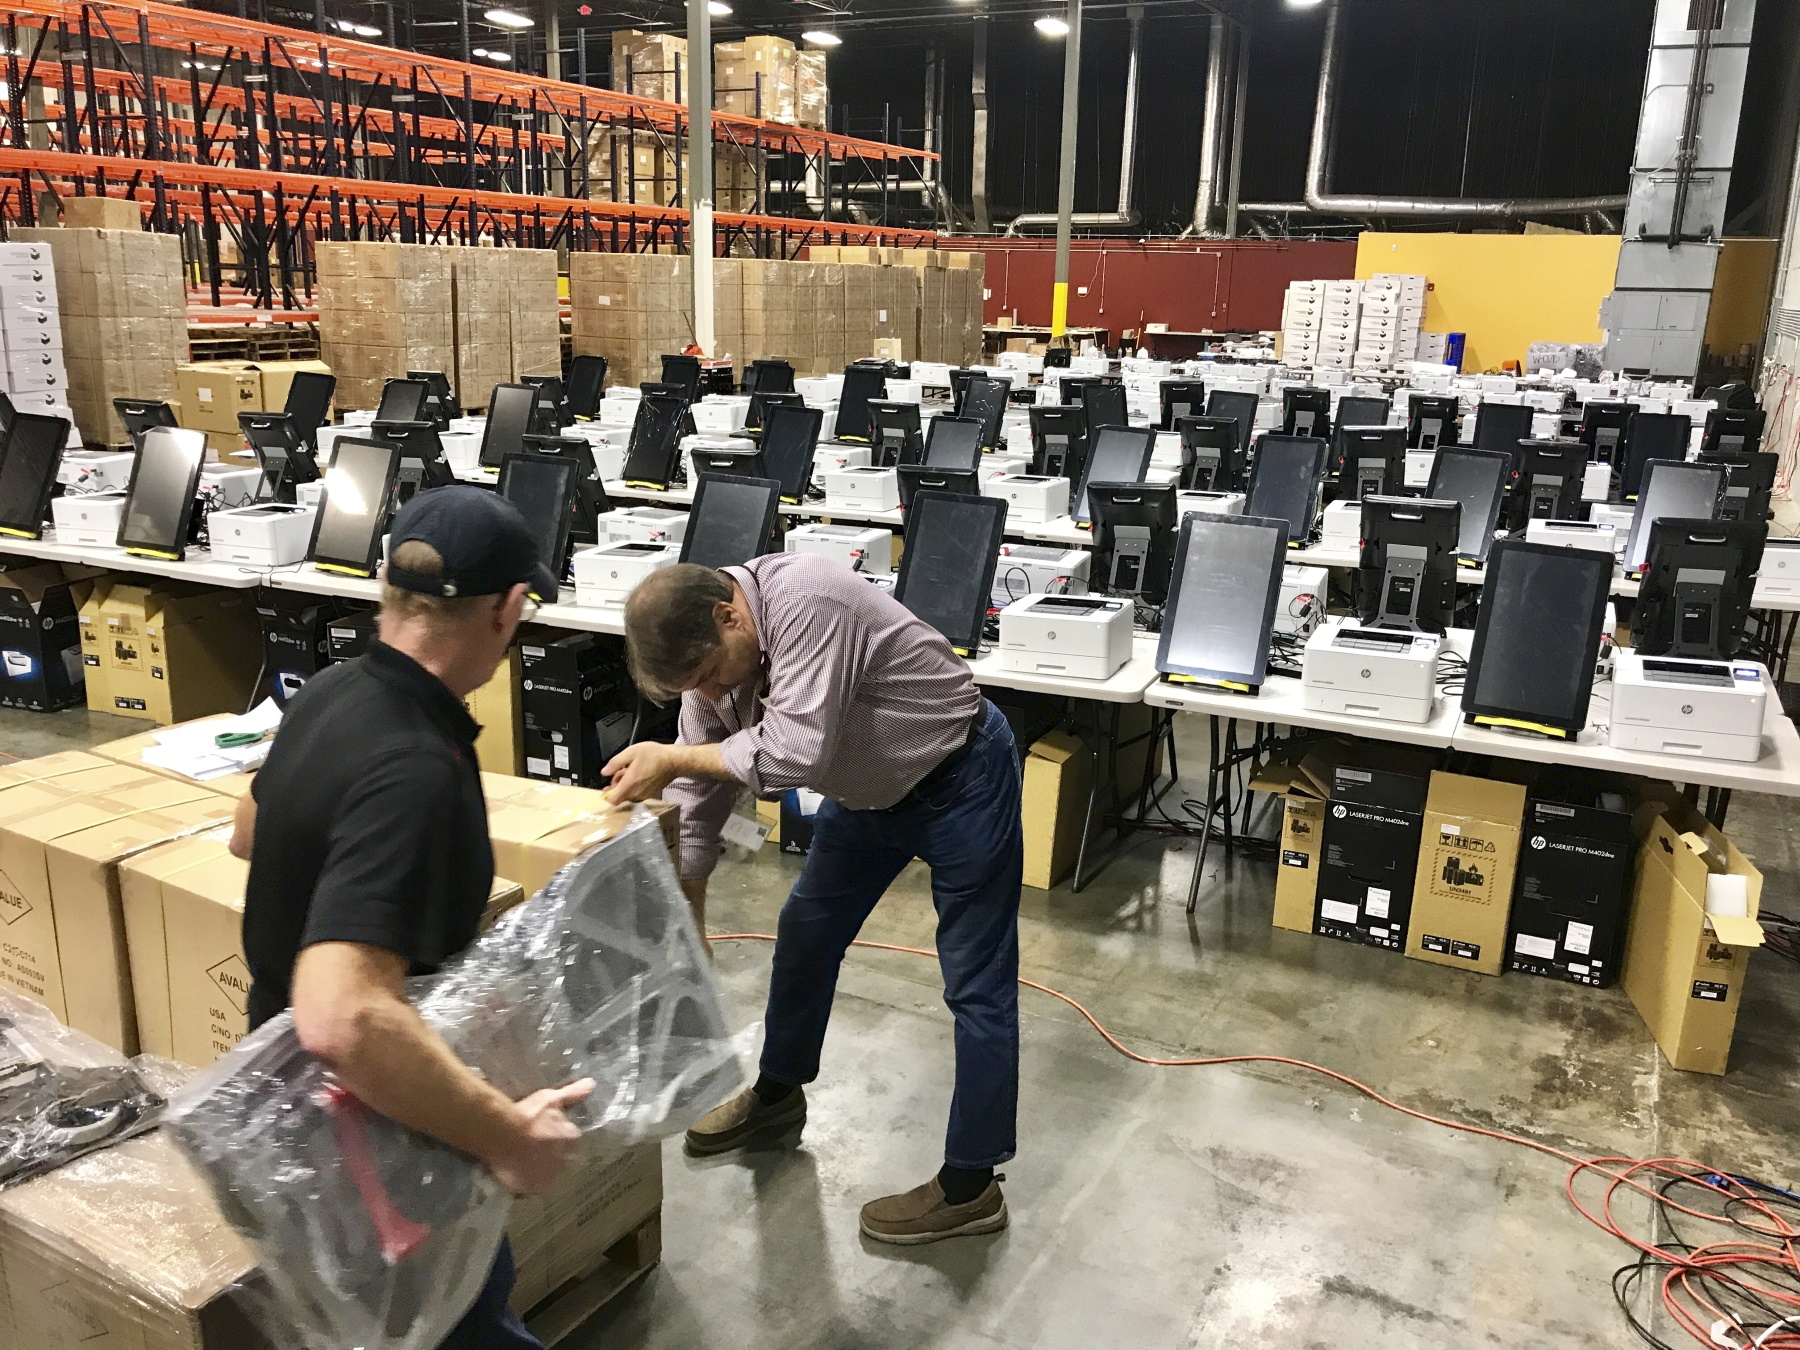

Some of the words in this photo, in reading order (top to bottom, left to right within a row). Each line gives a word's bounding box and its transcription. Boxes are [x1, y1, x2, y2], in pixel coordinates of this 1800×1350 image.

[1332, 804, 1347, 819] hp
[1349, 810, 1373, 821] LASERJET
[1530, 835, 1547, 850] hp
[1548, 842, 1574, 852] LASERJET
[1575, 846, 1588, 854] PRO
[16, 978, 44, 996] VIETNAM
[209, 1007, 227, 1022] USA
